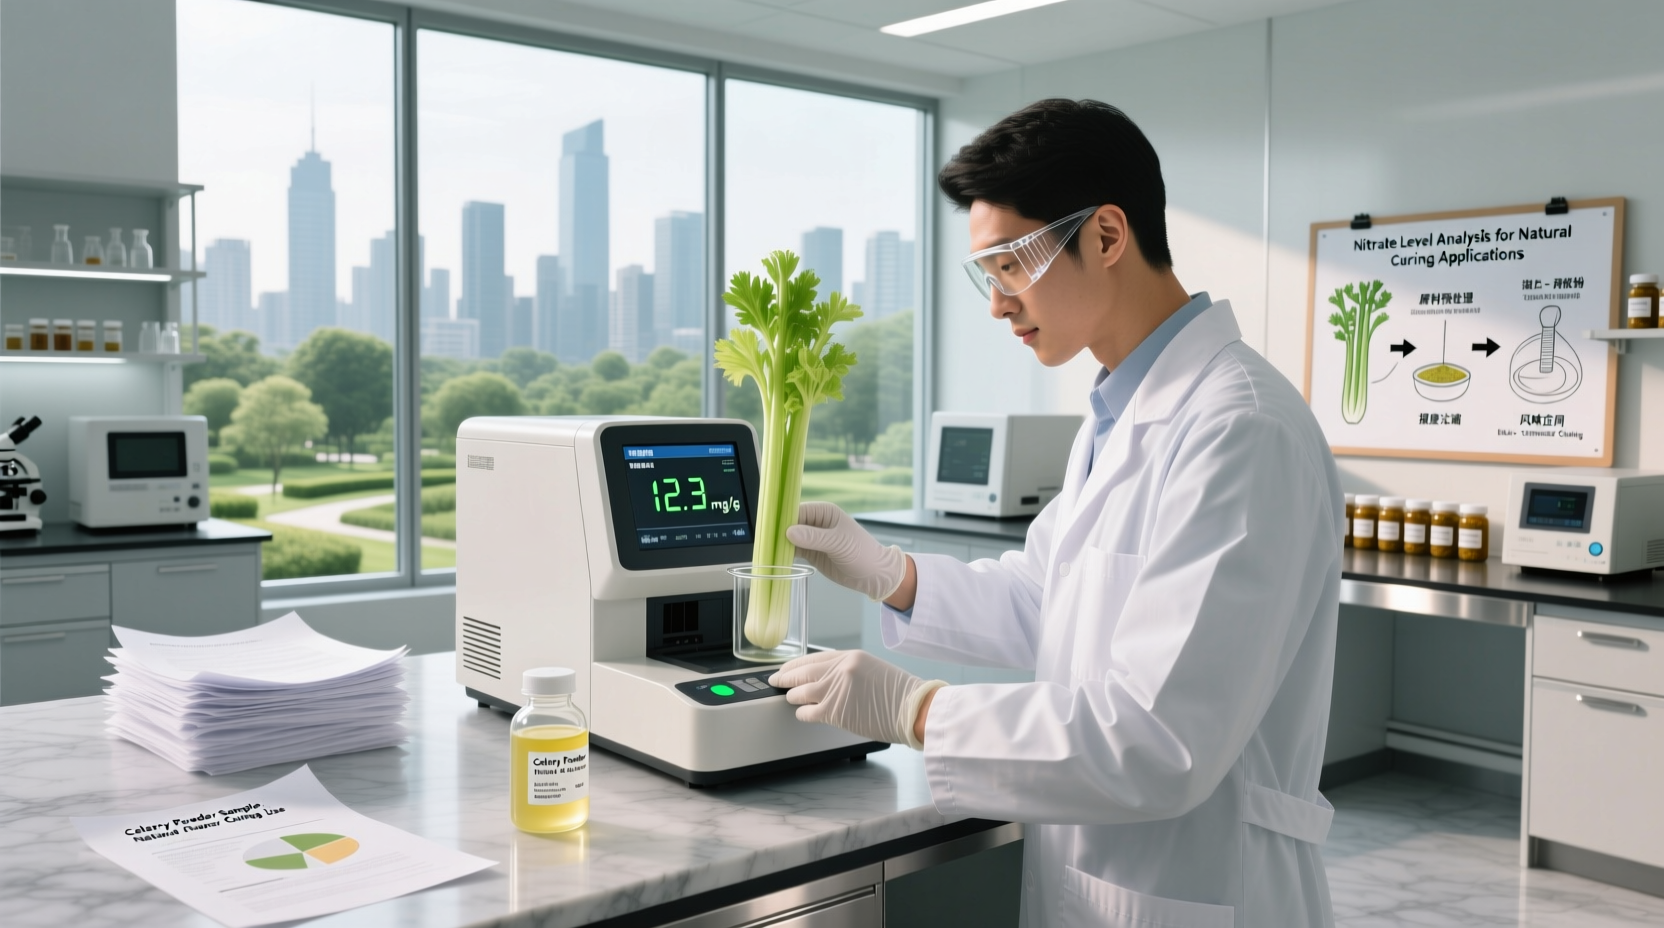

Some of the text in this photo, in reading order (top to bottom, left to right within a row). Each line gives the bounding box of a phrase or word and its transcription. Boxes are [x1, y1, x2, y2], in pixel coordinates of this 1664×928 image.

[1354, 224, 1572, 252] Nitrate Level Analysis for Natural
[1391, 247, 1525, 268] Curing Applications
[652, 477, 707, 512] 12.3
